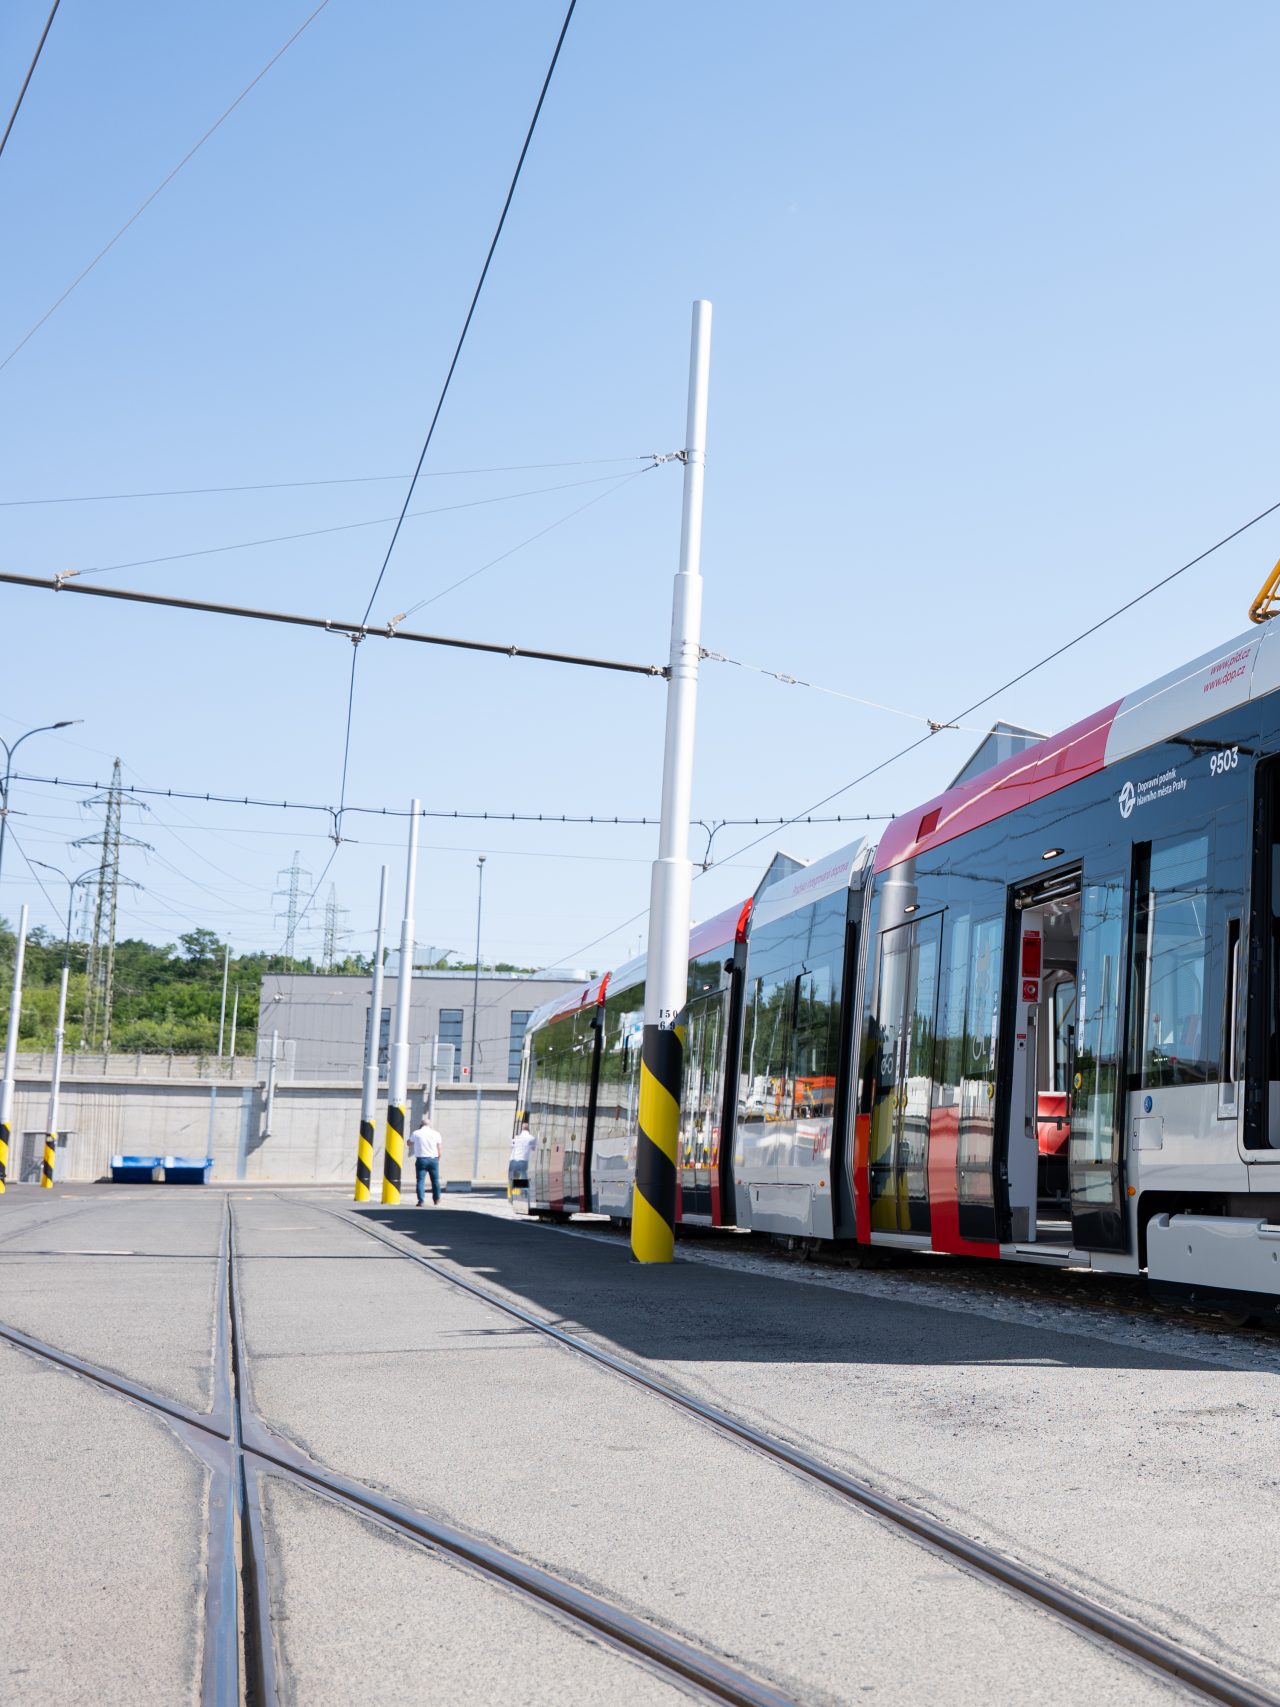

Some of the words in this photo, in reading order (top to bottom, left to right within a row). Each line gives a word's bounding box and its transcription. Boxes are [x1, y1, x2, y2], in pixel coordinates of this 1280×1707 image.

[1210, 648, 1251, 675] www.pid.cz
[1203, 665, 1246, 693] www.dpp.cz
[1210, 745, 1239, 777] 9503
[1136, 790, 1157, 806] hlavního
[1157, 785, 1172, 798] města
[1172, 777, 1188, 792] Prahy
[1137, 774, 1159, 793] Dopravní
[1158, 767, 1177, 786] podnik
[659, 1009, 678, 1019] 150
[660, 1020, 676, 1031] 69
